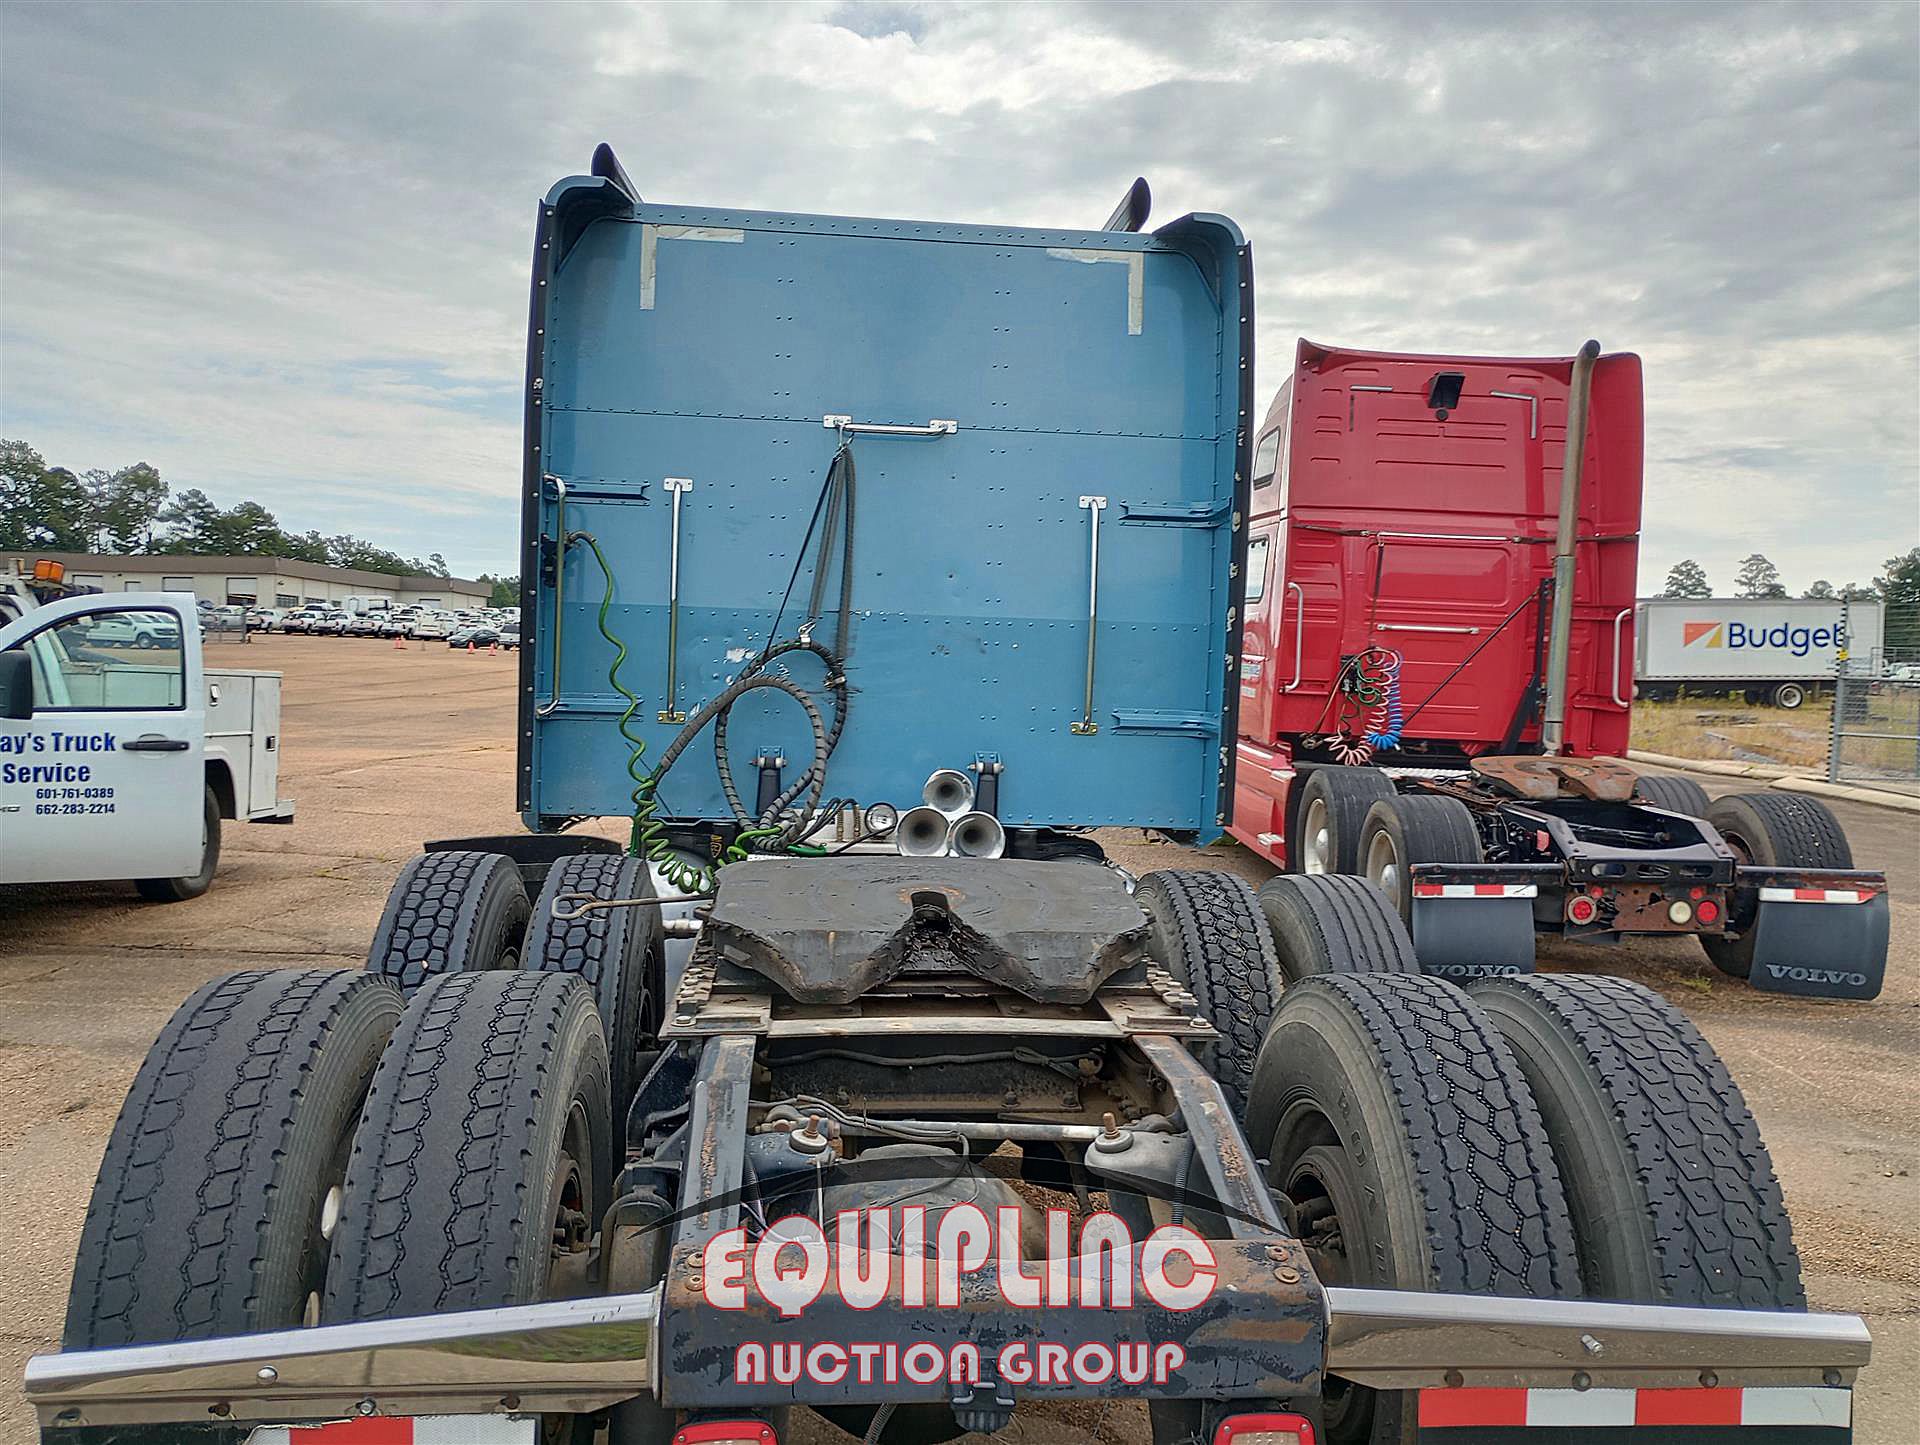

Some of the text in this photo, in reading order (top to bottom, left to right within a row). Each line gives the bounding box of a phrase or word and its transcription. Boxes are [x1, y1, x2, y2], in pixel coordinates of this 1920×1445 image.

[1727, 622, 1841, 657] Budget
[51, 732, 116, 752] Truck
[3, 762, 91, 783] Service
[36, 788, 114, 799] 601-761-0389
[36, 804, 115, 815] 662-283-2214
[1425, 964, 1521, 977] VOLVO
[1765, 964, 1867, 986] VOLVO
